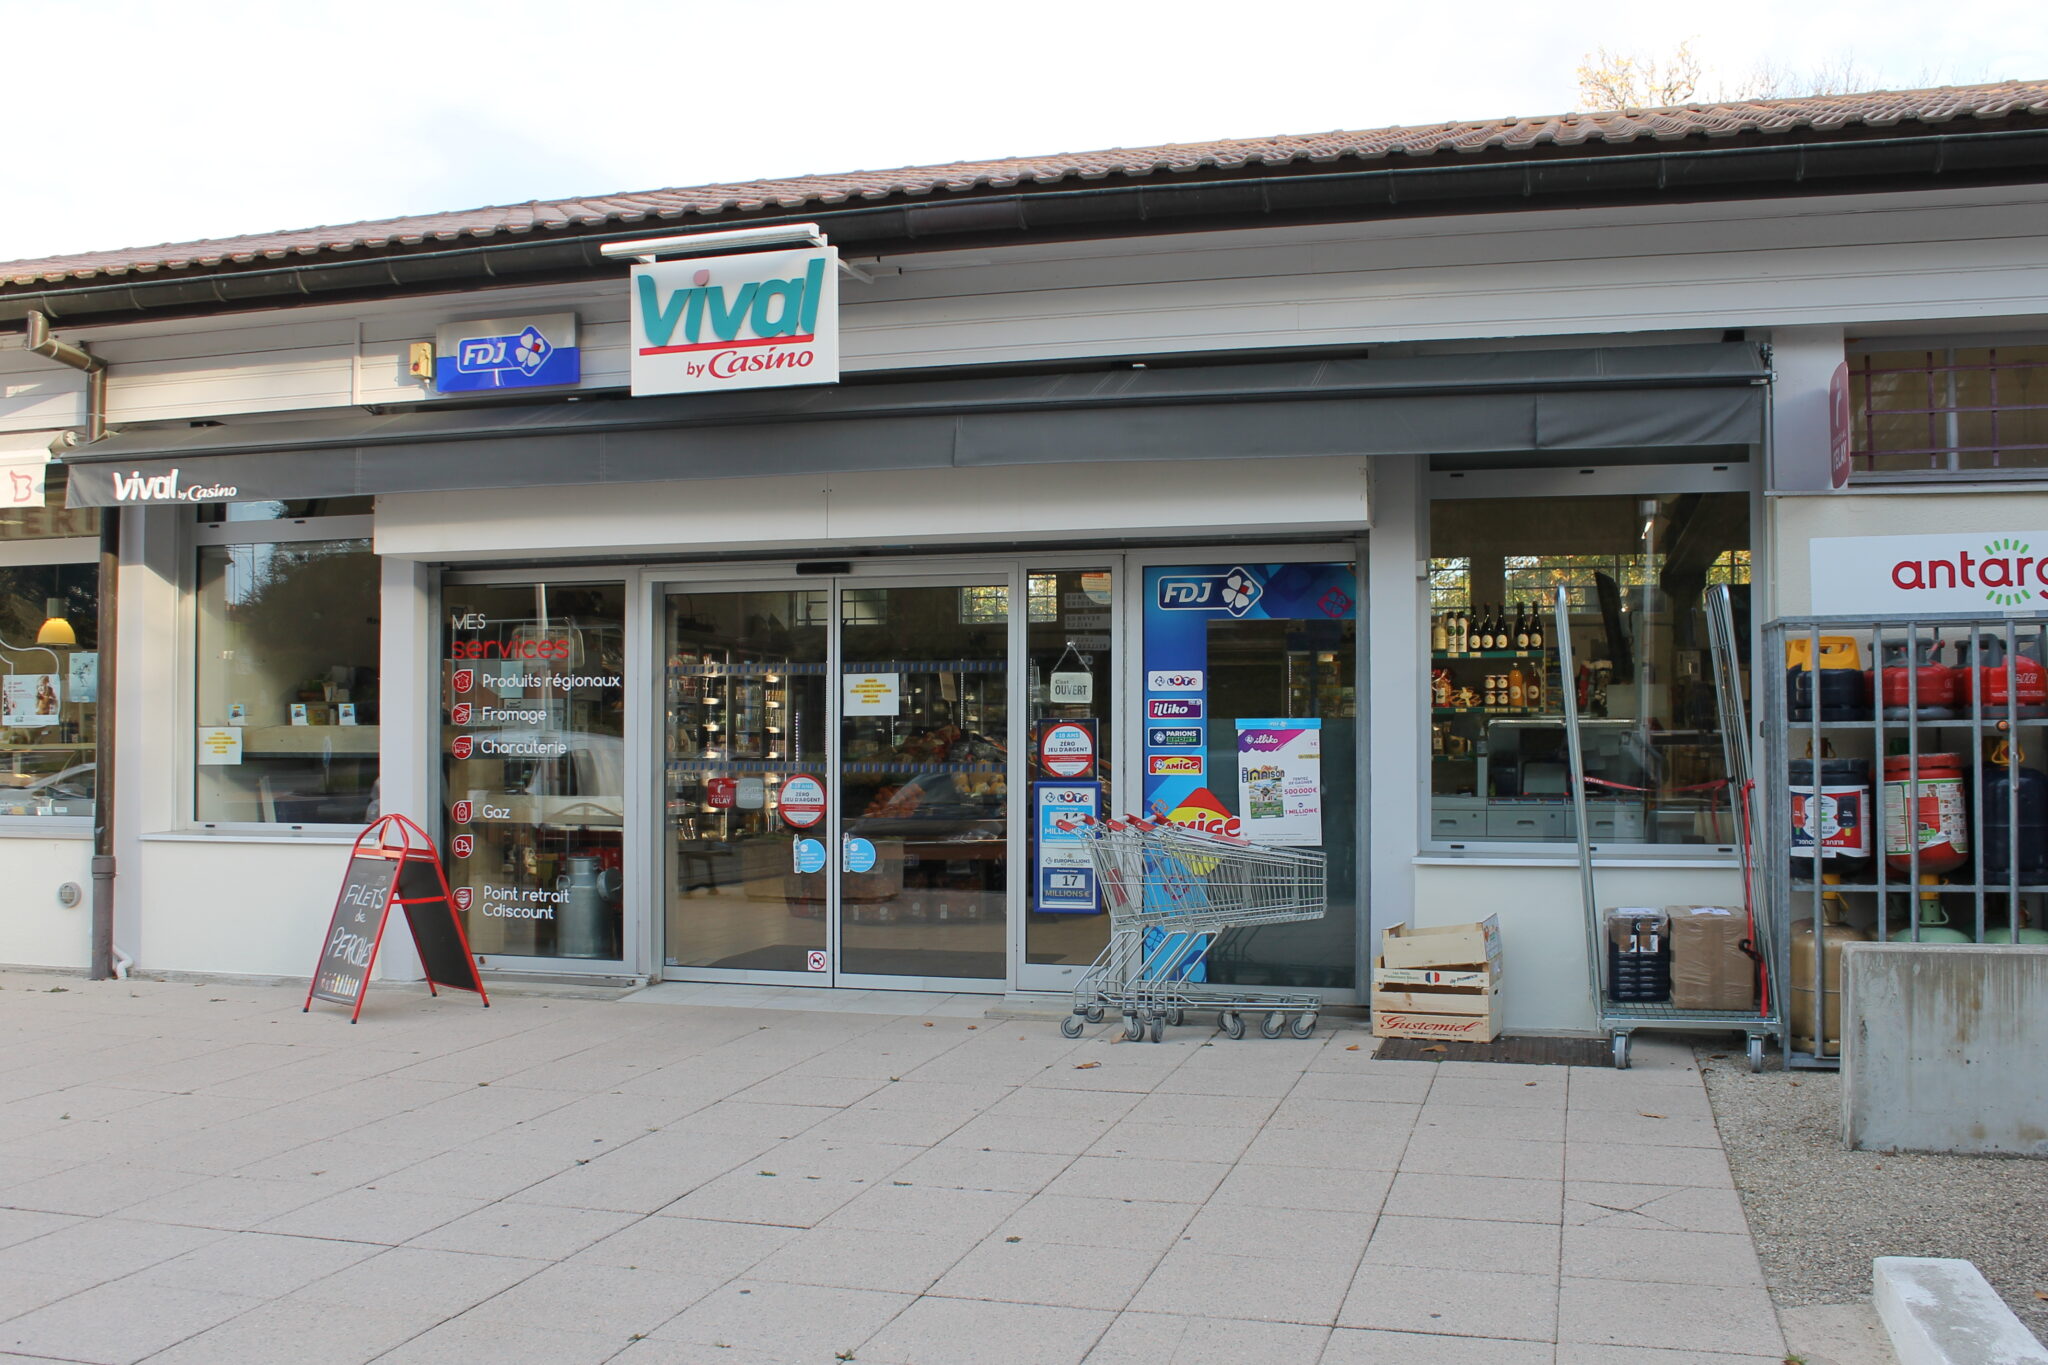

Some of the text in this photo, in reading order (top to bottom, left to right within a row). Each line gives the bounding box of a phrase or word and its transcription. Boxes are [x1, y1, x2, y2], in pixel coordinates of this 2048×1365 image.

[637, 258, 826, 347] Vival
[463, 342, 507, 366] FDJ
[687, 347, 814, 379] by Casino
[113, 468, 179, 501] Vival
[187, 483, 238, 501] Casino
[1164, 582, 1212, 603] FDJ
[452, 613, 486, 630] MES
[451, 635, 570, 659] services
[482, 672, 620, 691] Produits régionaux
[1167, 675, 1197, 686] LOTO
[1055, 684, 1088, 696] OUVERT
[482, 706, 547, 724] Fromage
[1153, 702, 1188, 716] illiko
[481, 739, 567, 754] Charcuterie
[1057, 791, 1089, 803] LOTO
[482, 804, 511, 819] Gaz
[1062, 875, 1078, 887] 17
[483, 885, 570, 903] Point retrait
[482, 902, 554, 920] Cdiscount
